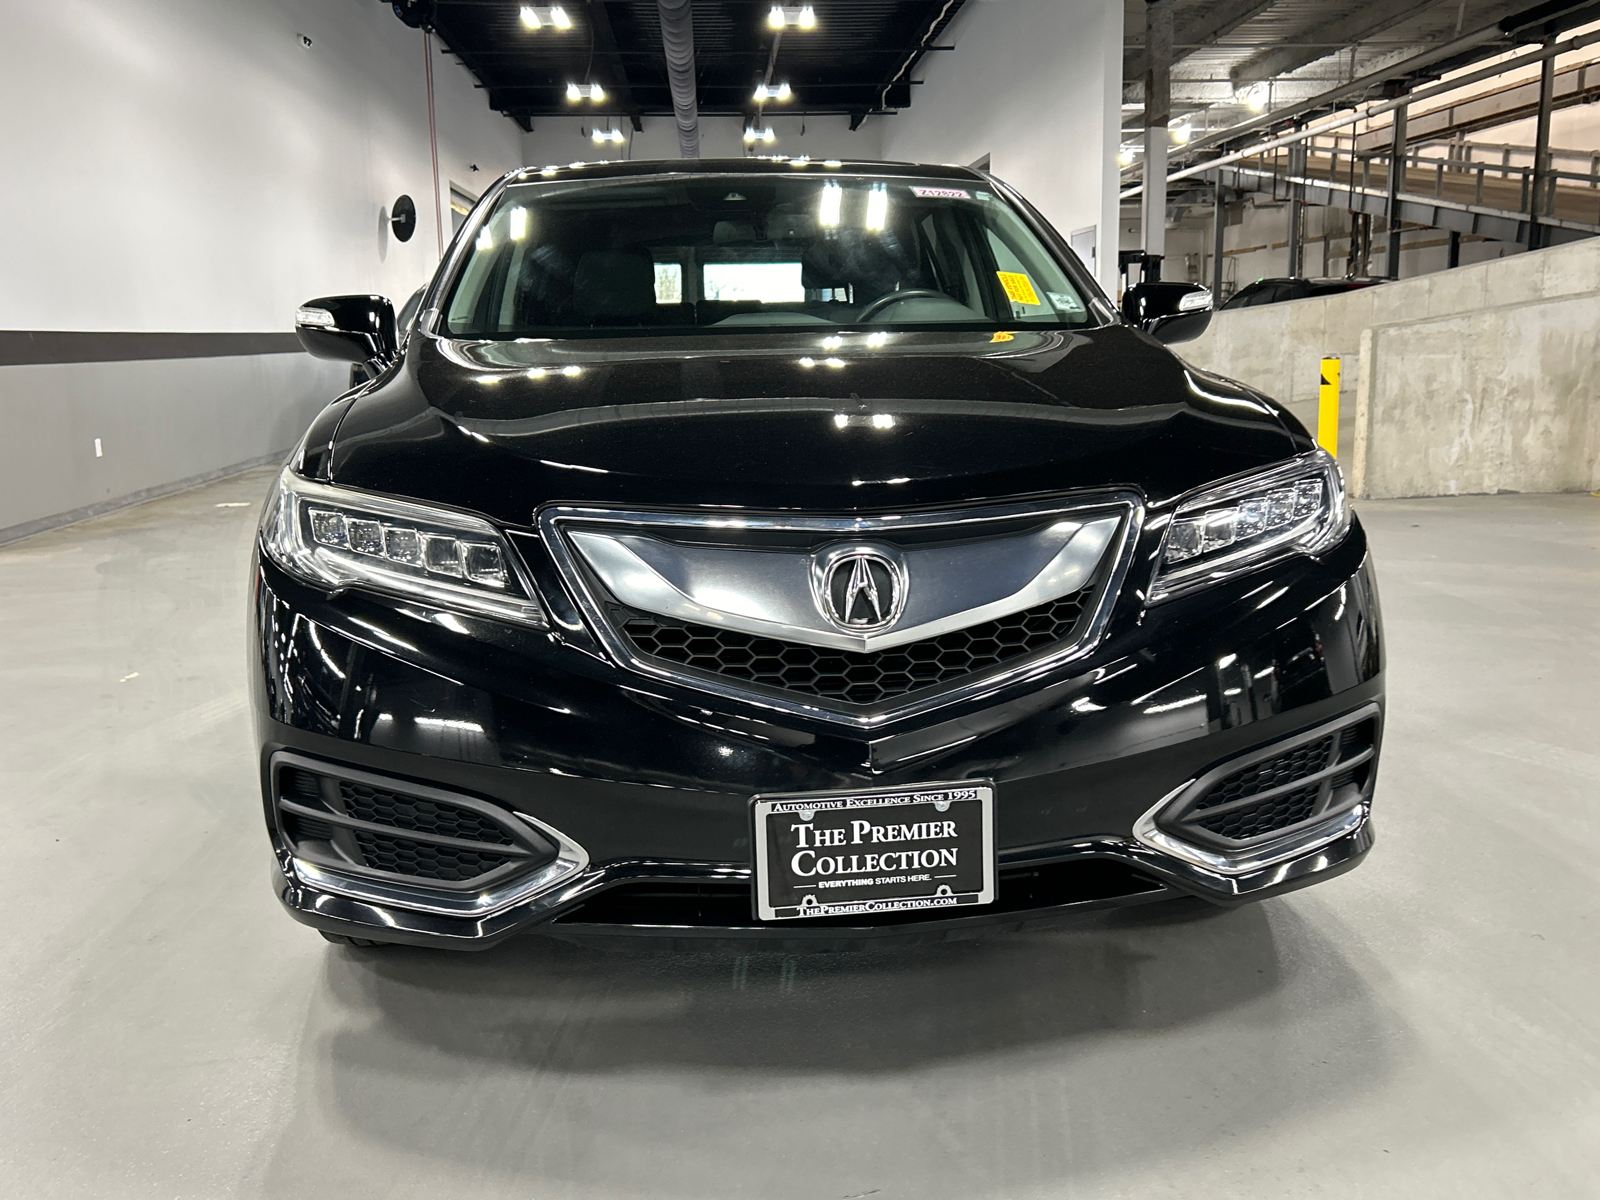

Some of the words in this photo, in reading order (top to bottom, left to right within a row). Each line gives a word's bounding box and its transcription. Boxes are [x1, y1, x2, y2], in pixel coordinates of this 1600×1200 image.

[774, 801, 843, 811] AUTOMOTIVE
[846, 795, 910, 808] EXCELLENCE
[913, 793, 944, 803] SINCE
[947, 790, 975, 800] 1995
[791, 823, 846, 848] THE
[850, 820, 958, 844] PREMIER
[791, 848, 958, 876] COLLECTION
[819, 878, 873, 888] EVERYTHING
[875, 875, 906, 884] STARTS
[908, 874, 932, 882] HERE.
[797, 897, 957, 916] THEPREMIERCOLLECTION.COM
